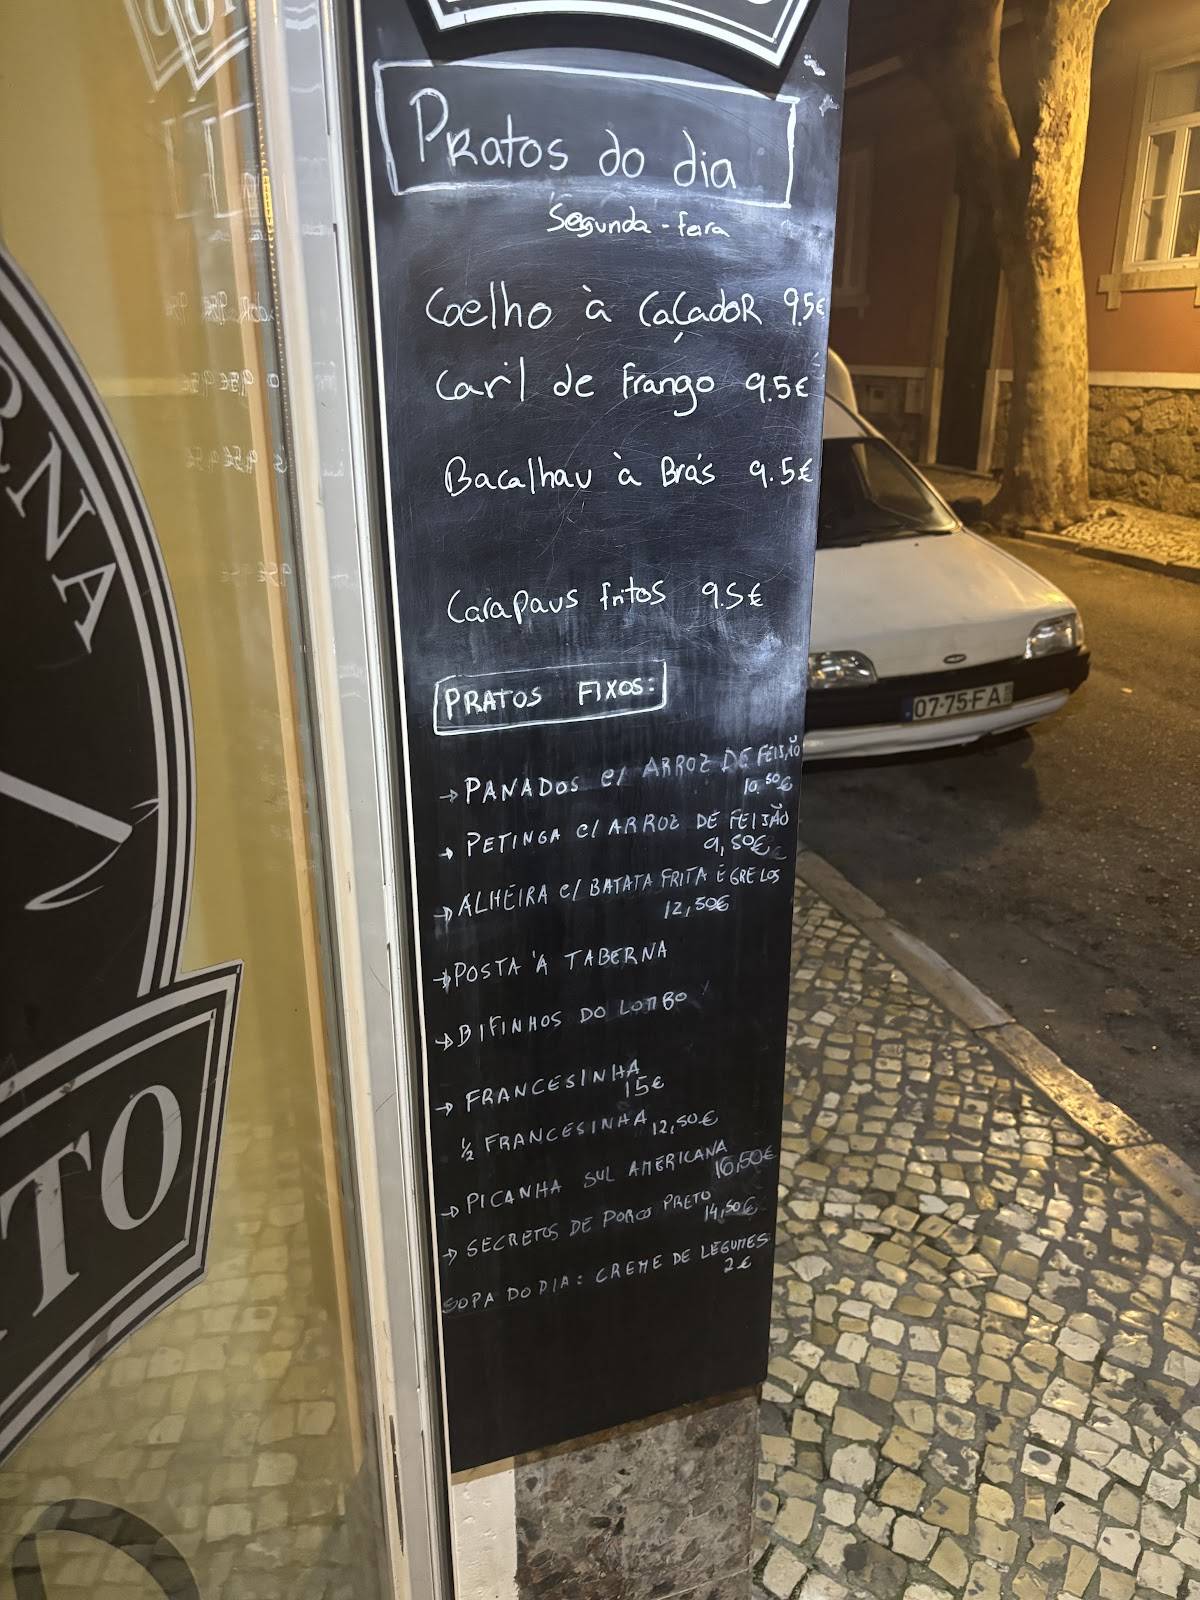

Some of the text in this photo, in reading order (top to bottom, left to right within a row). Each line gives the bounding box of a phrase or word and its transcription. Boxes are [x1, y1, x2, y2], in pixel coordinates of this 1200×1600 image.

[599, 129, 645, 178] do
[673, 130, 737, 189] dia
[547, 203, 652, 238] Segunda
[425, 281, 552, 329] Coelho
[583, 285, 612, 323] à
[436, 357, 525, 401] Caril
[553, 363, 595, 398] de
[444, 452, 814, 497] Bacalhau à Brás 9.5€
[447, 589, 579, 625] Carapaus
[702, 581, 764, 610] 9.5€
[445, 687, 543, 721] PRATOS
[465, 776, 580, 805] PANADOS
[642, 753, 712, 779] ARROZ
[722, 746, 752, 773] DE
[467, 828, 561, 858] PETINGA
[608, 813, 681, 836] ARROZ
[697, 810, 721, 830] DE
[729, 802, 790, 831] FEIJÃO
[457, 884, 548, 917] ALHEIRA
[589, 872, 654, 897] BATATA
[661, 866, 708, 889] FRITA
[729, 866, 781, 886] GRELOS
[454, 957, 523, 988] POSTA
[564, 940, 668, 971] TABERNA
[458, 990, 688, 1048] BIFINHOS DO LOMBO
[465, 1058, 640, 1113] FRANCESINHA
[625, 1075, 665, 1098] 15€
[485, 1109, 648, 1153] FRANCESINHA
[466, 1139, 728, 1215] PICANHA SUL AMERICANA
[0, 1084, 183, 1337] TO
[467, 1190, 712, 1258] SECRETOS DE PORCO PRETO
[442, 1292, 495, 1315] SOPA
[507, 1285, 532, 1302] DO
[595, 1254, 663, 1284] CREME
[673, 1248, 691, 1266] DE
[700, 1232, 770, 1260] LEGUMES
[723, 1255, 753, 1274] 2€
